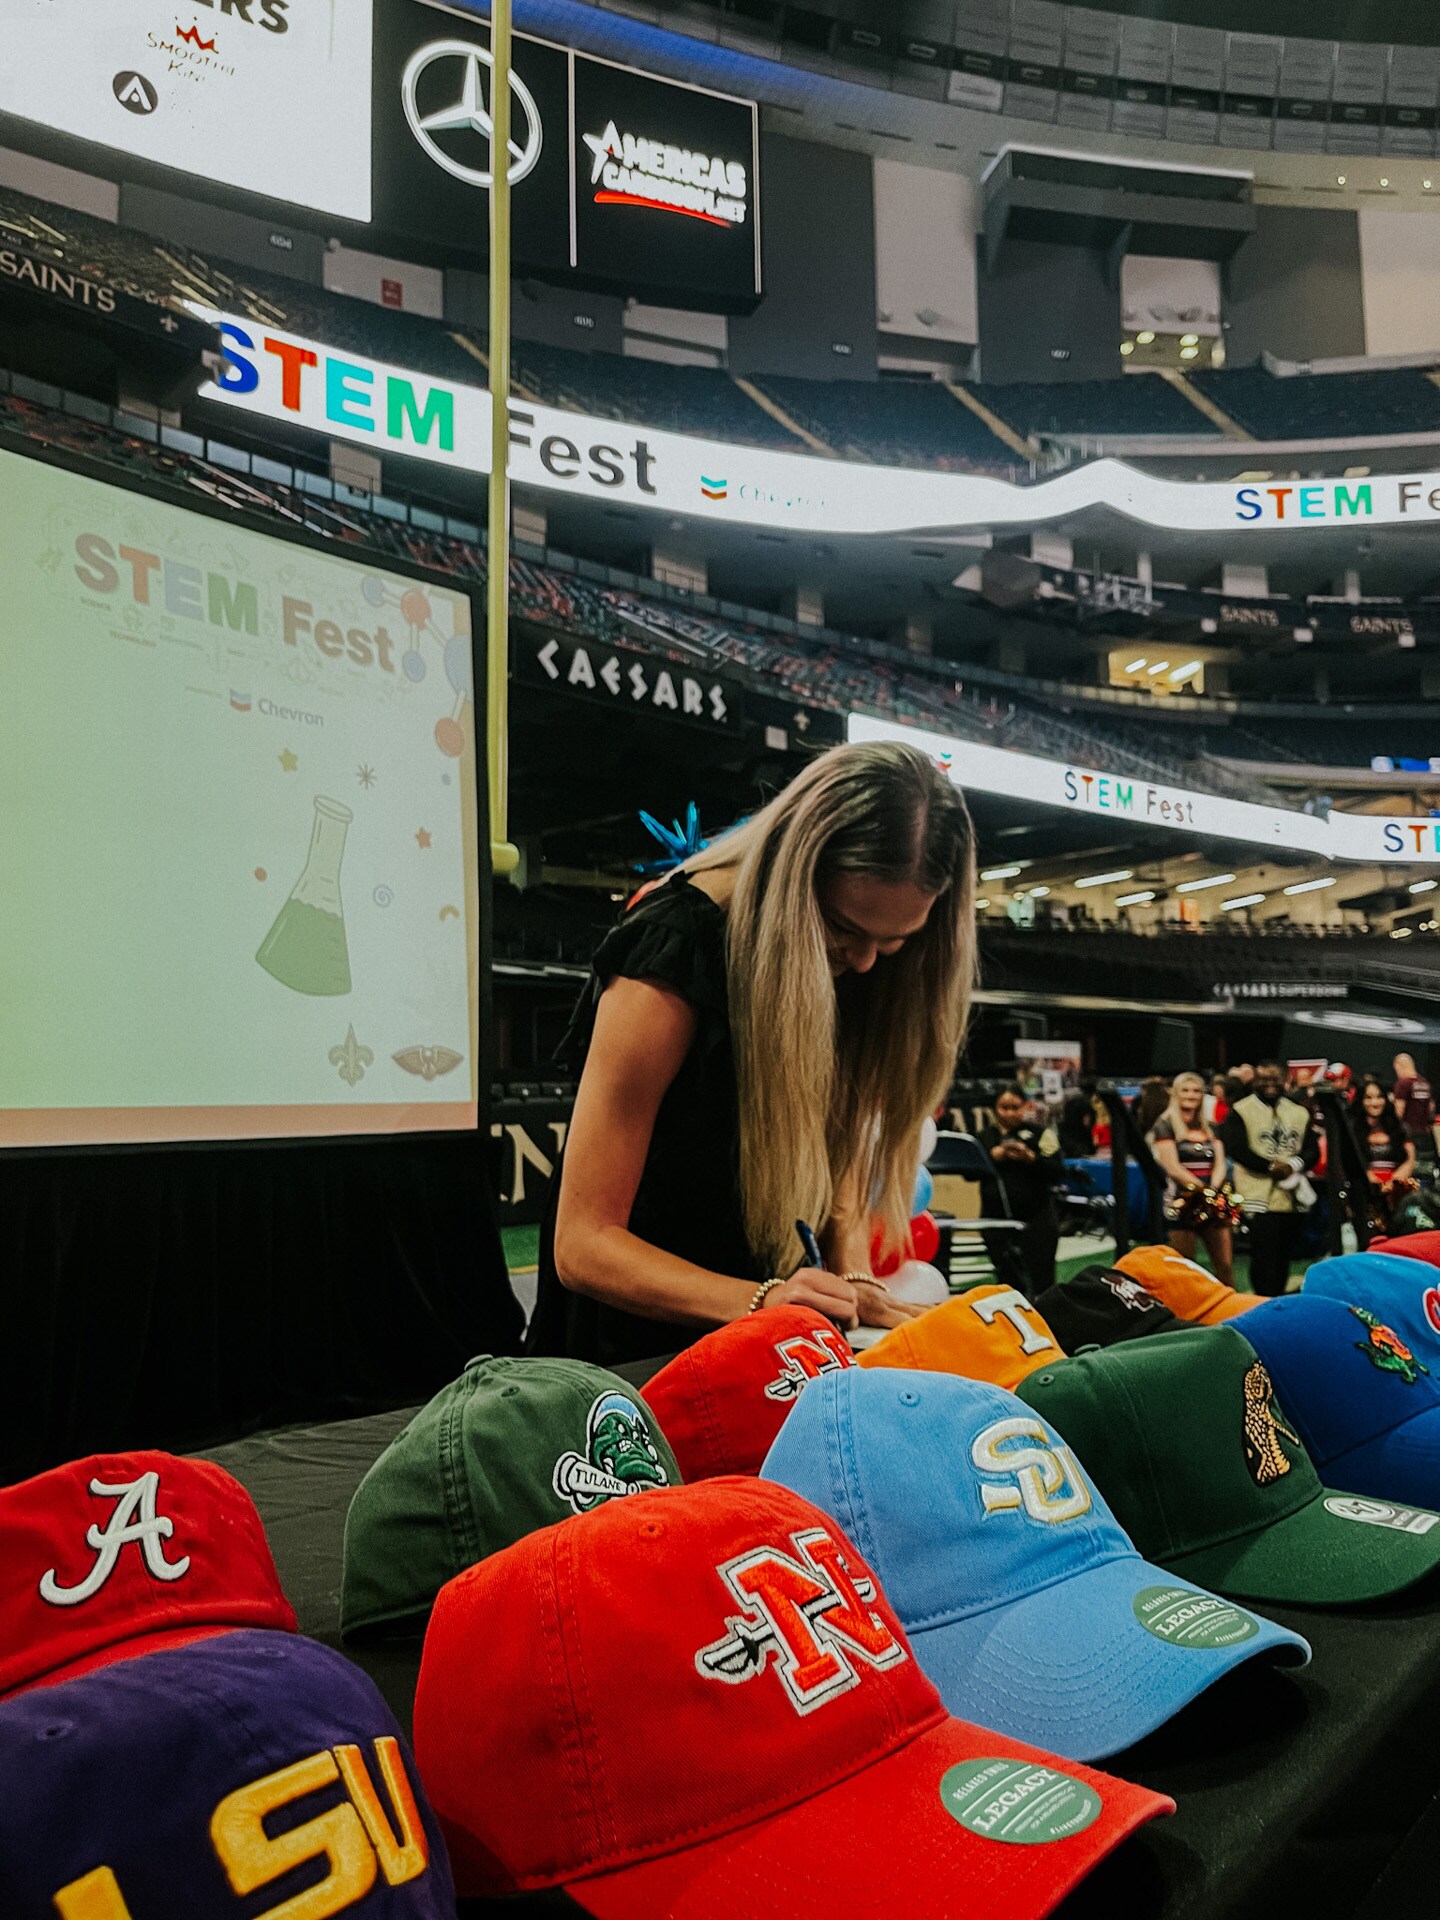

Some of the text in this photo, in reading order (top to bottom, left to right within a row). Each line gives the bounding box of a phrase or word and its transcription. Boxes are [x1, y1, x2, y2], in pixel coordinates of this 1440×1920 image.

[0, 250, 116, 313] SAINTS
[219, 322, 454, 452] STEM
[1235, 485, 1373, 521] STEM
[73, 532, 396, 674] STEM Fest
[537, 638, 728, 722] CAESARS
[257, 697, 325, 728] Chevron
[1065, 770, 1194, 824] STEM Fest
[969, 1289, 1054, 1356] T
[575, 1468, 622, 1492] TULANE
[40, 1471, 191, 1605] A
[1155, 1599, 1226, 1636] LEGACY
[971, 1767, 1060, 1831] LEGACY
